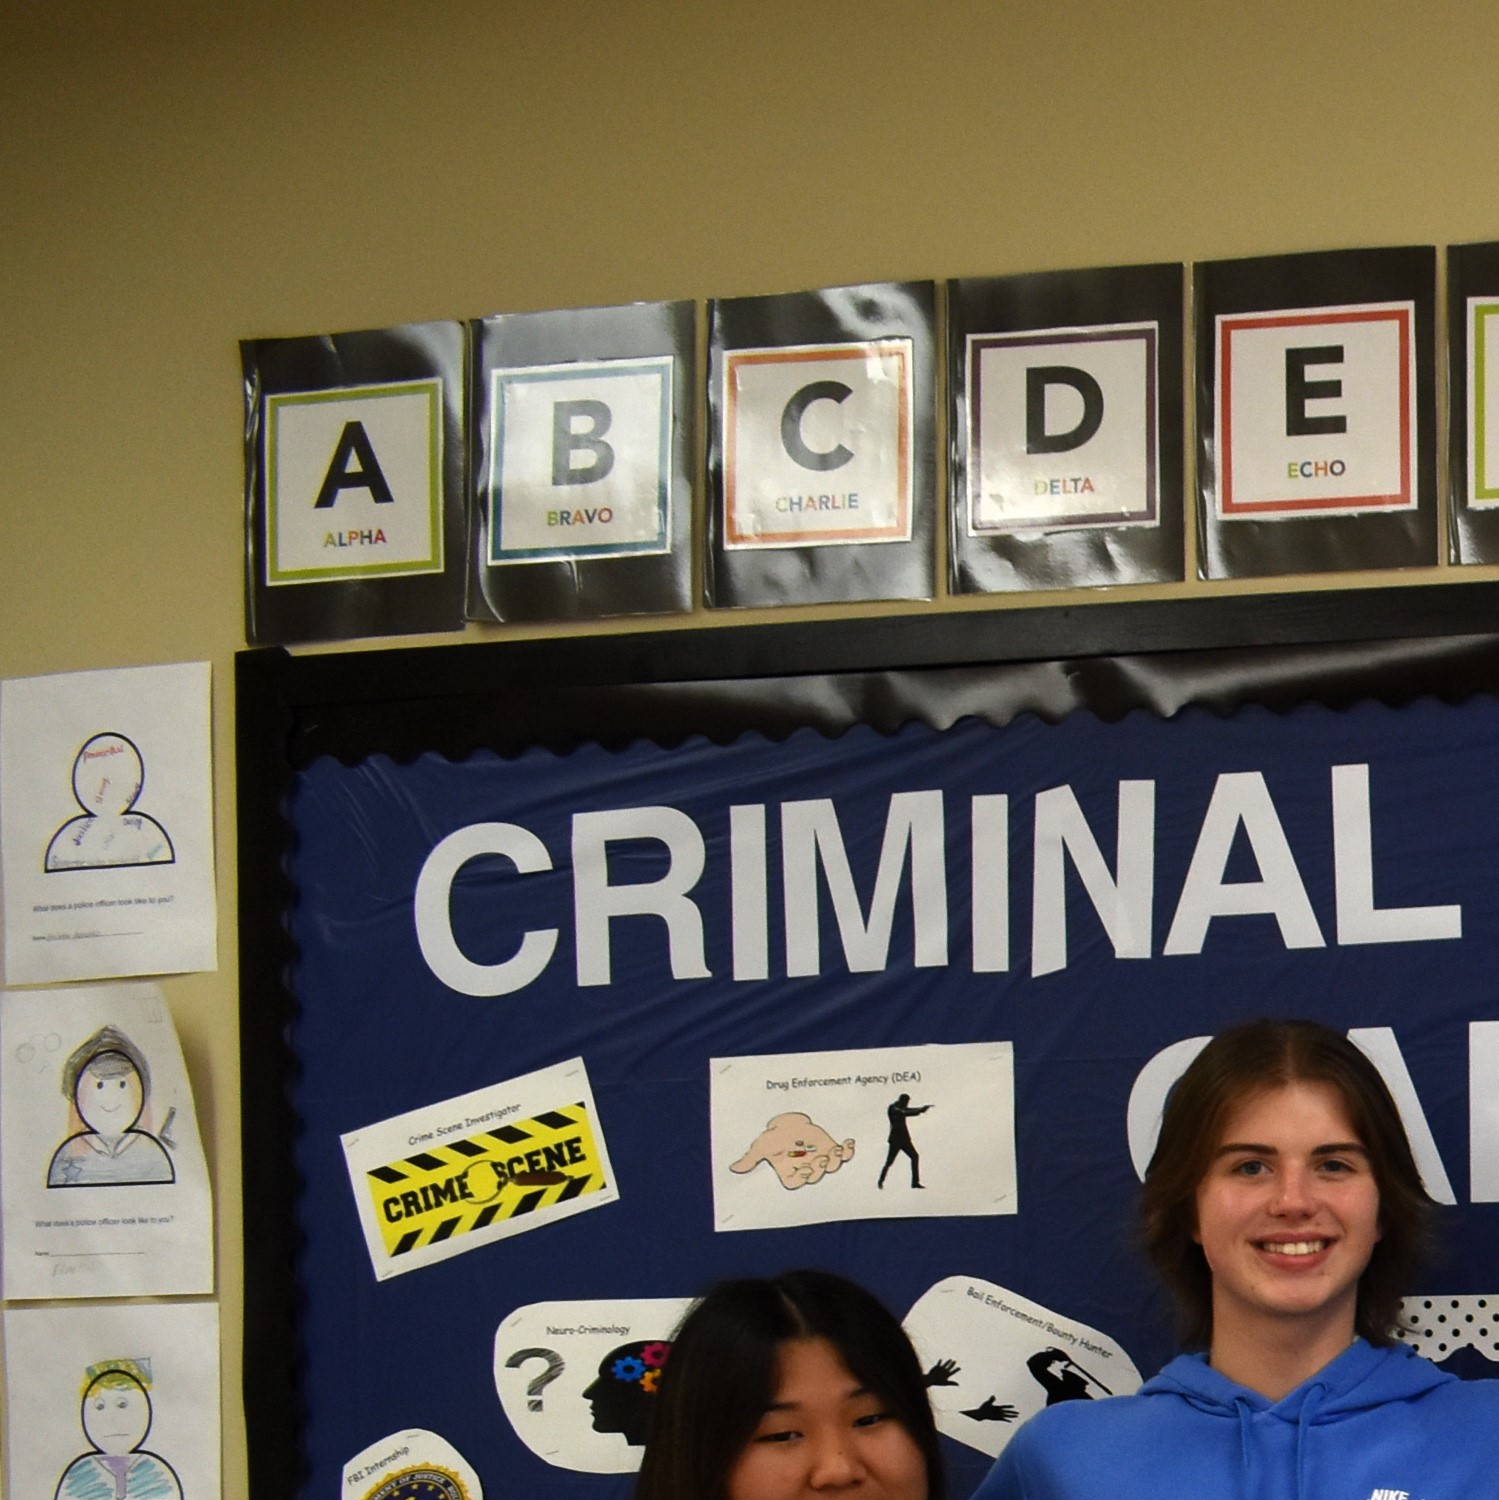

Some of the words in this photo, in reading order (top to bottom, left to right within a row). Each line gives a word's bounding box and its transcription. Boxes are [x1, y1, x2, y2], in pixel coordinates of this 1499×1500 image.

[1026, 366, 1104, 455] D
[1285, 345, 1347, 436] E
[552, 400, 615, 486] B
[781, 379, 854, 472] C
[314, 420, 394, 508] A
[1287, 459, 1346, 479] ECHO
[776, 493, 859, 513] CHARLIE
[1034, 477, 1094, 496] DELTA
[323, 529, 388, 548] ALPHA
[547, 507, 613, 528] BRAVO
[413, 763, 1463, 997] CRIMINAL
[766, 1080, 789, 1091] Drug
[792, 1076, 852, 1088] Enforcement
[855, 1074, 889, 1085] Agency
[891, 1071, 922, 1084] (DEA)
[408, 1132, 434, 1146] Crime
[436, 1122, 463, 1138] Scene
[465, 1103, 521, 1129] Investigator
[382, 1170, 474, 1224] CRIME
[494, 1136, 586, 1191] SCENE
[546, 1325, 631, 1337] Neuro-Criminology
[966, 1286, 985, 1300] Bail
[1079, 1337, 1113, 1358] Hunter
[348, 1470, 366, 1486] FBI
[365, 1446, 410, 1476] Internship
